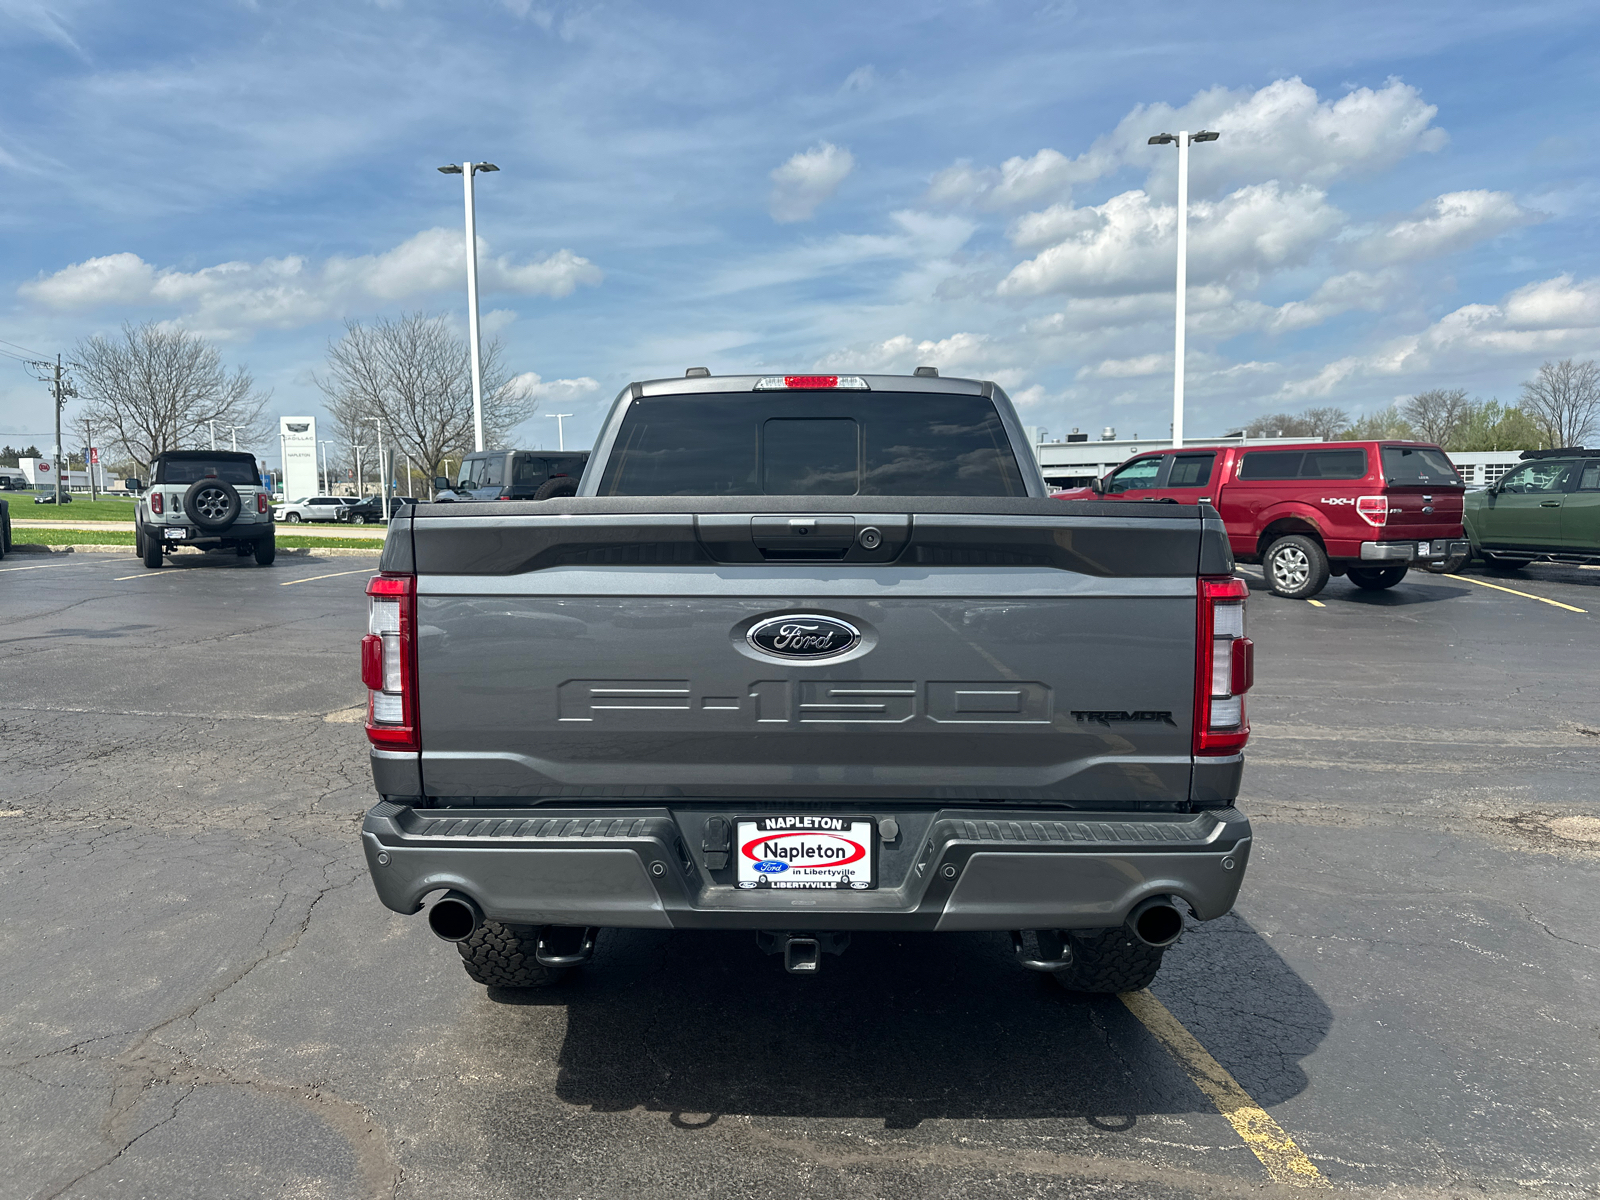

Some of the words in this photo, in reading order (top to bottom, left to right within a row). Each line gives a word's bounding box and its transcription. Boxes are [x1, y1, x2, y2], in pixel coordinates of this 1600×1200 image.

[773, 623, 834, 649] Ford
[557, 679, 1055, 726] F-150
[1070, 710, 1178, 727] TREMOR
[765, 816, 842, 830] NAPLETON
[763, 842, 845, 862] Napleton
[759, 861, 783, 872] Ford
[803, 868, 856, 877] Libertyville
